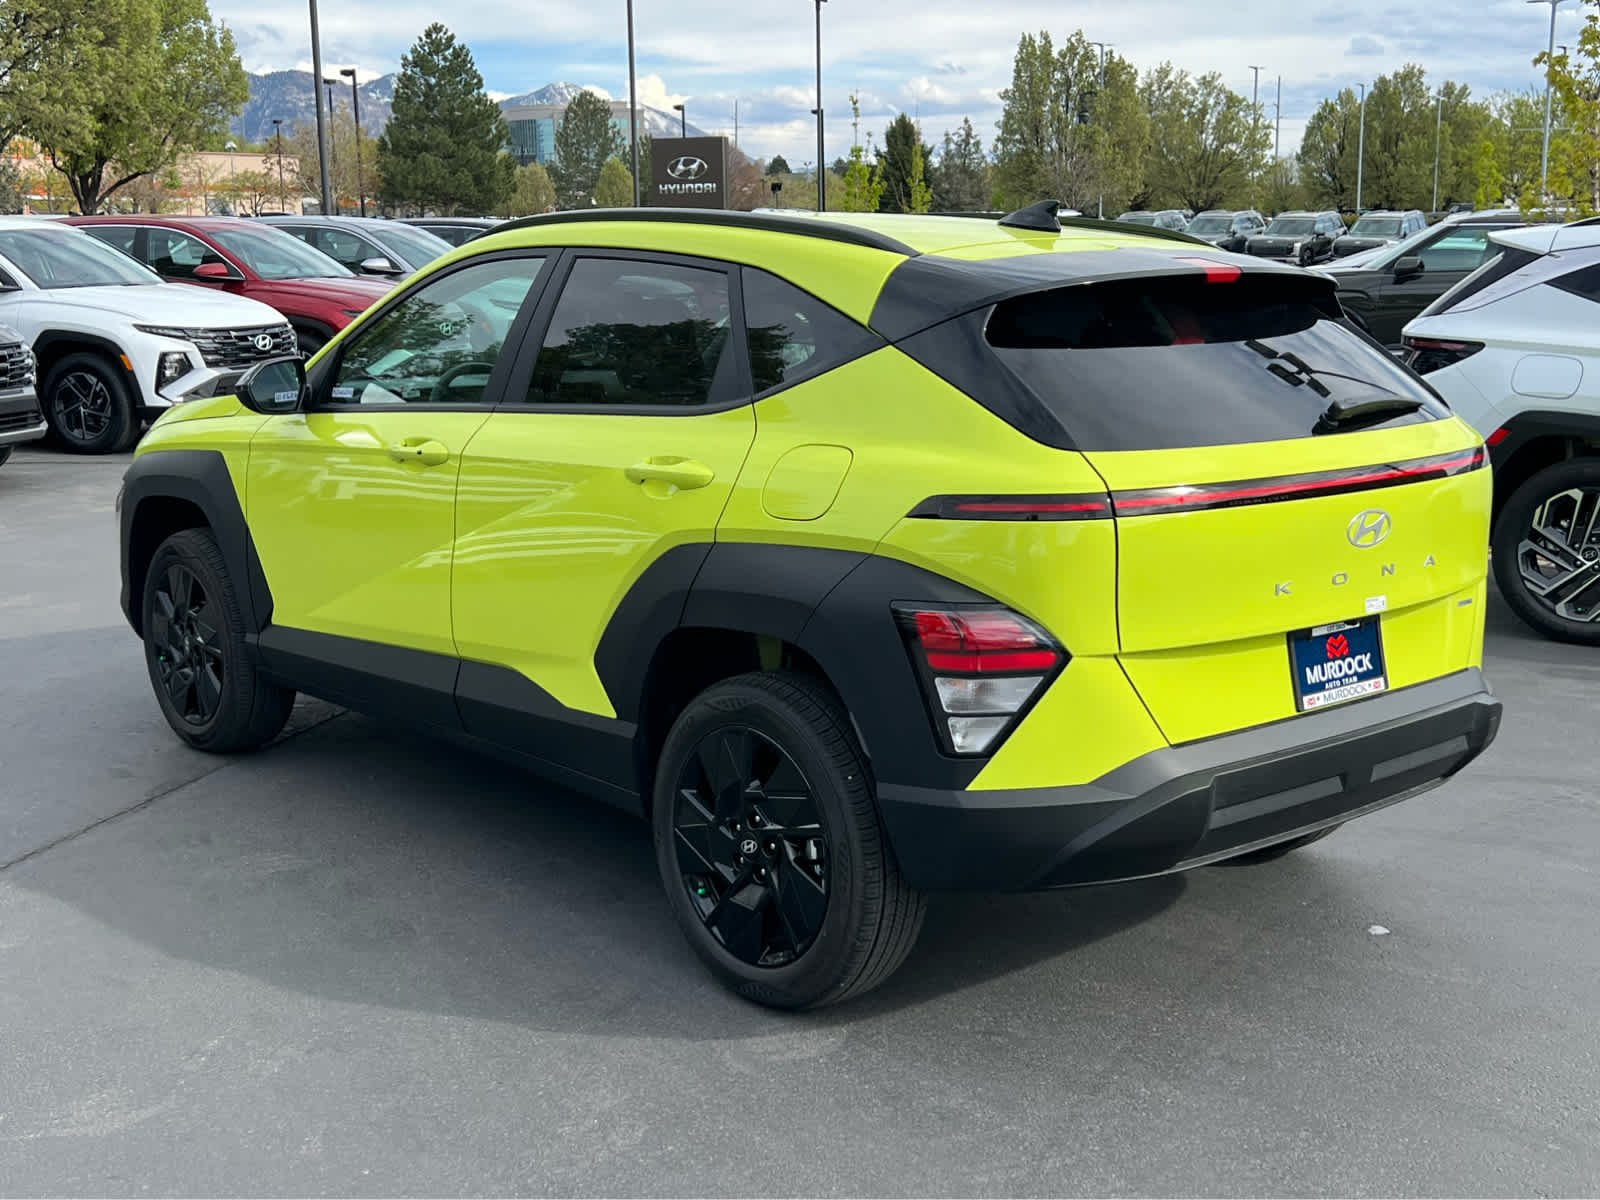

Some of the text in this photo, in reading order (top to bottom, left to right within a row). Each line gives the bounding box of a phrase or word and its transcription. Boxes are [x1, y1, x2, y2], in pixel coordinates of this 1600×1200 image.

[659, 183, 717, 195] HYUNDAI
[1305, 652, 1374, 685] MURDOCK
[1325, 675, 1358, 690] AUTO TEAM
[1322, 684, 1368, 703] MURDOCK
